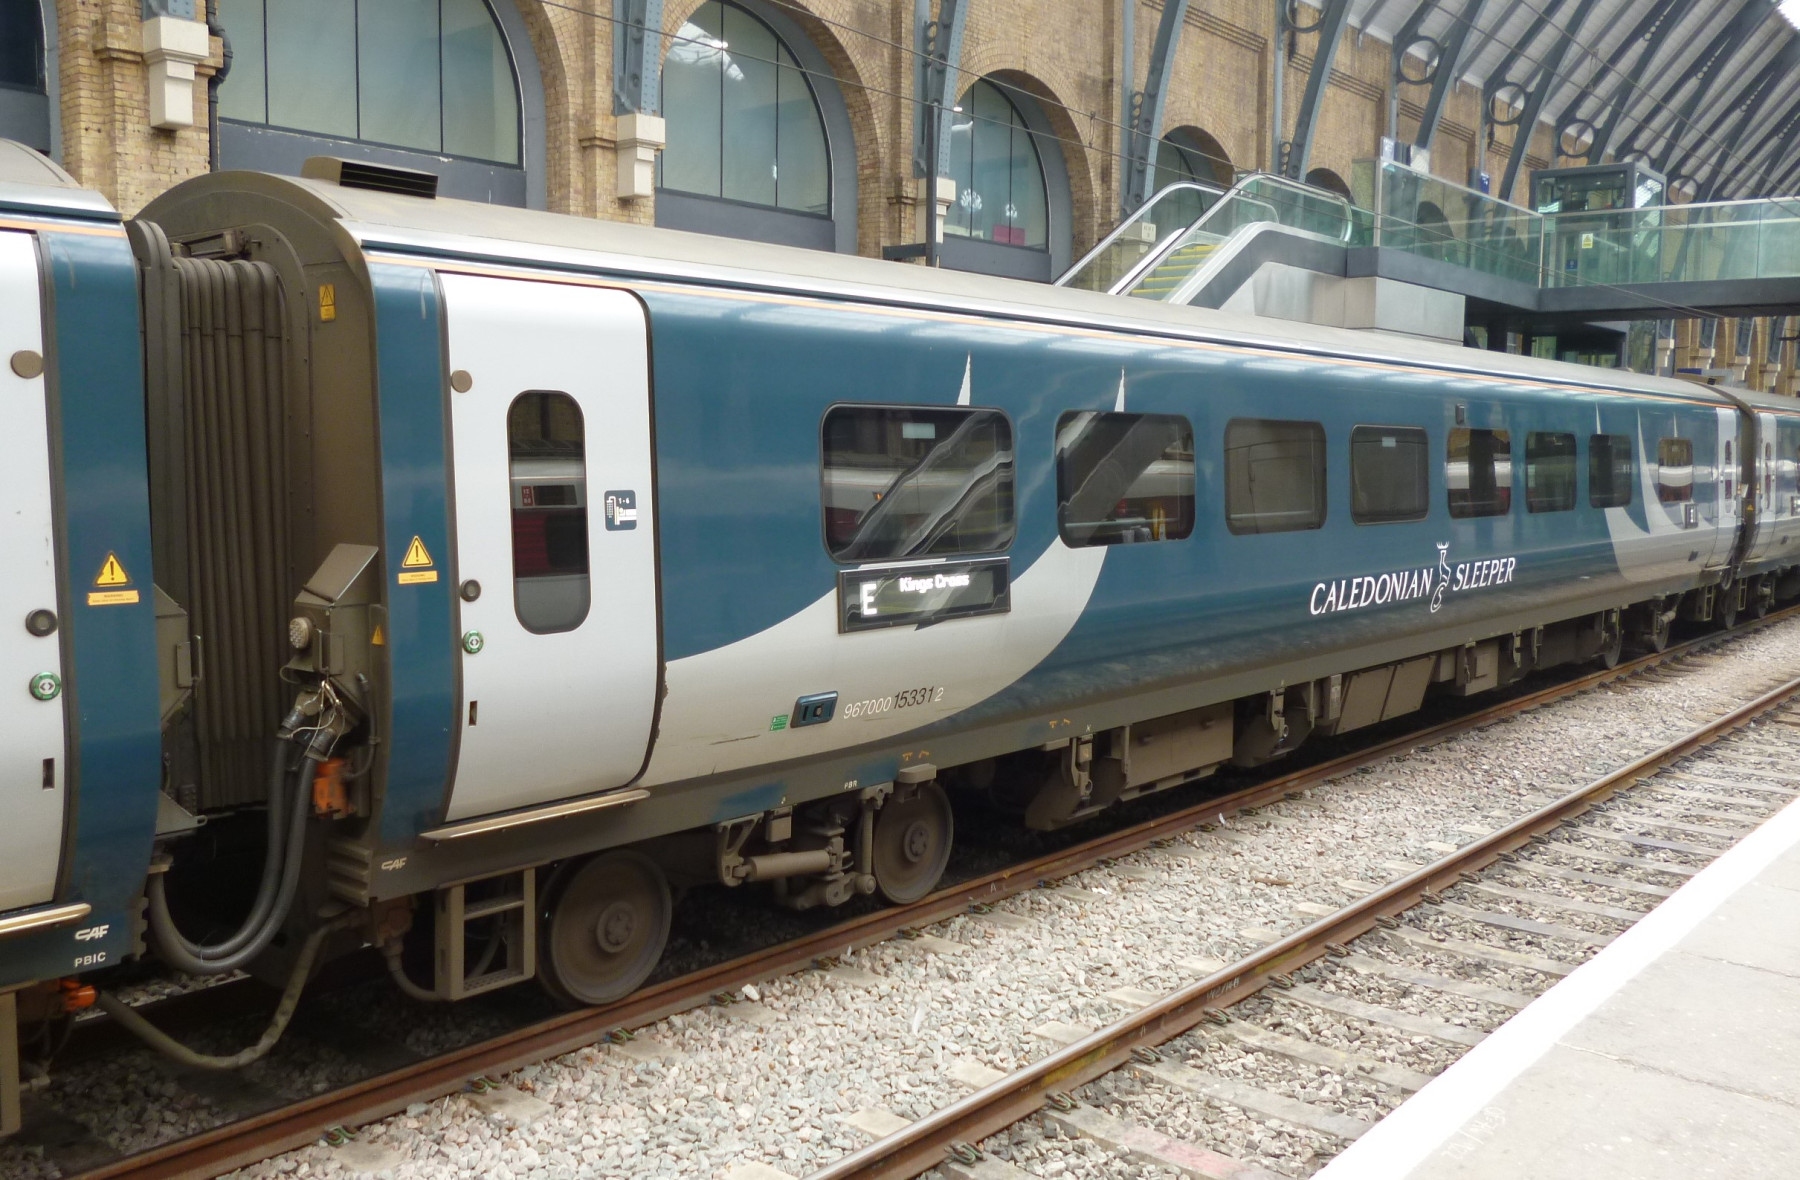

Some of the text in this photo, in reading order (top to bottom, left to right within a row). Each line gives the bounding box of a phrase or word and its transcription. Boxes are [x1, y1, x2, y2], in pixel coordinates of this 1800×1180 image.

[899, 574, 969, 593] Kings Cross
[1310, 557, 1516, 615] CALEDONIAN SLEEPER
[862, 583, 877, 615] E
[381, 857, 407, 871] CAF
[75, 924, 109, 940] CAF
[74, 951, 106, 968] PBIC
